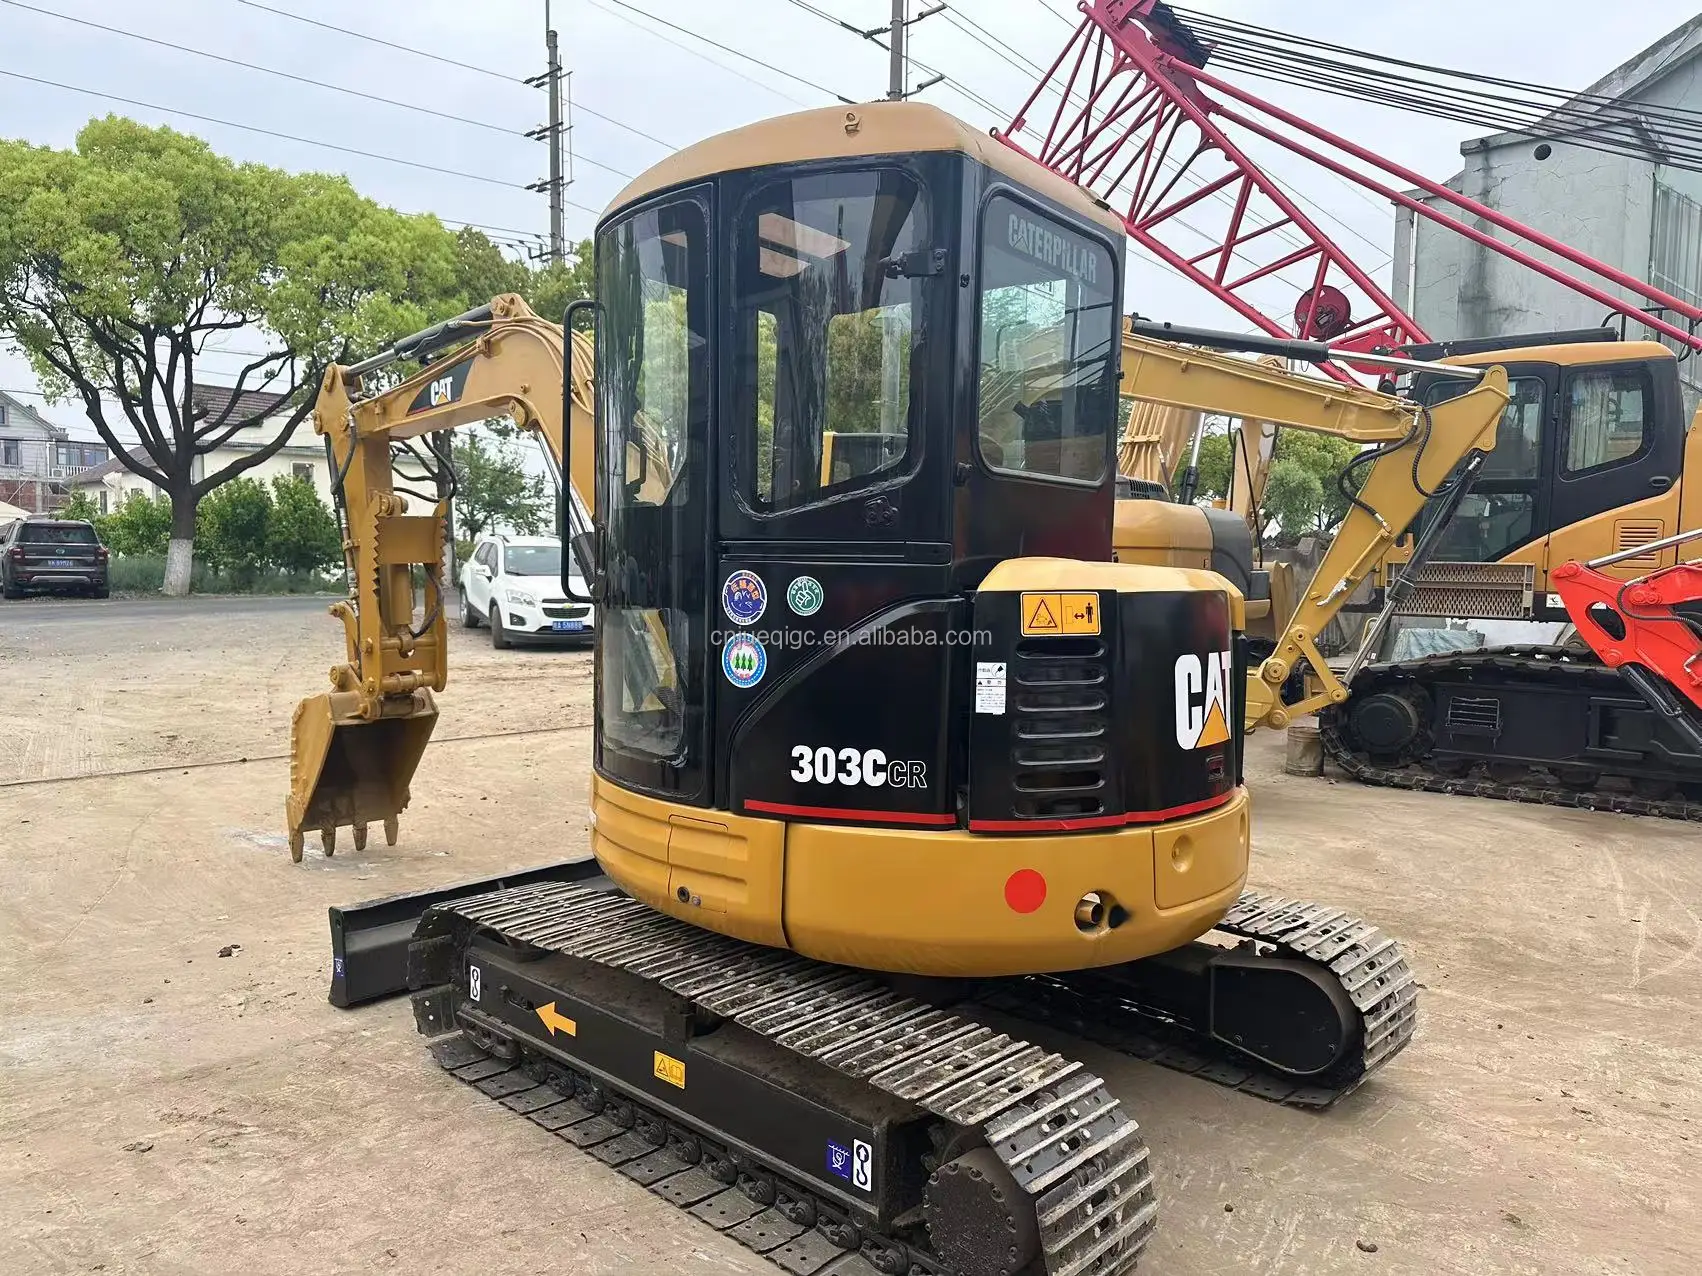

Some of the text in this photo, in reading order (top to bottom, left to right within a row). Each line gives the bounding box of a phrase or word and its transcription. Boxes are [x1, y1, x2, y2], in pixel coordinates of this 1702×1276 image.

[1008, 213, 1097, 284] CATERPILLAR
[430, 376, 453, 407] CAT
[1174, 651, 1231, 750] CAT
